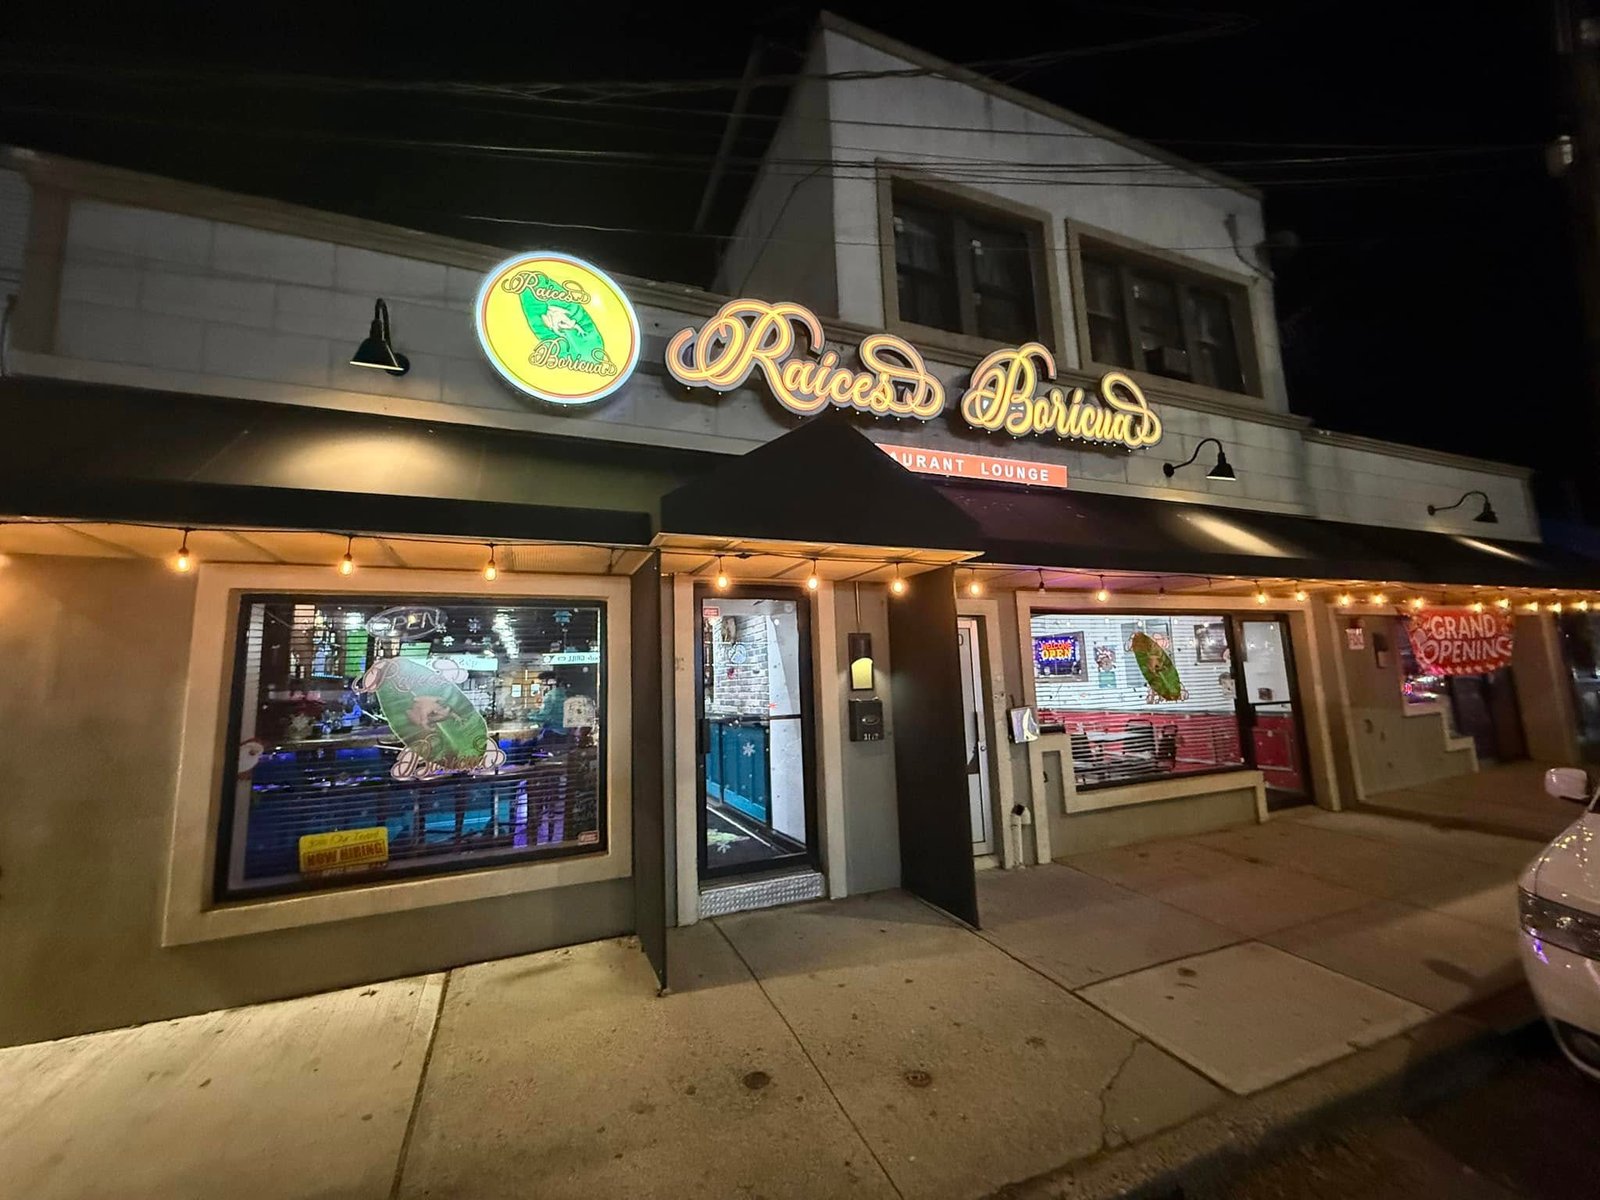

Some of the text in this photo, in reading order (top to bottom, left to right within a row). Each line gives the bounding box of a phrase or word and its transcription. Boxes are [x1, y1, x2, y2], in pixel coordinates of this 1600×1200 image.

[501, 270, 591, 304] Raices
[528, 336, 617, 376] Boricua
[666, 298, 1163, 449] Raices Boricua
[981, 463, 1049, 482] LOUNGE
[1041, 642, 1073, 650] WELCOME
[1041, 649, 1072, 660] OPEN
[1421, 614, 1512, 664] GRAND OPENING
